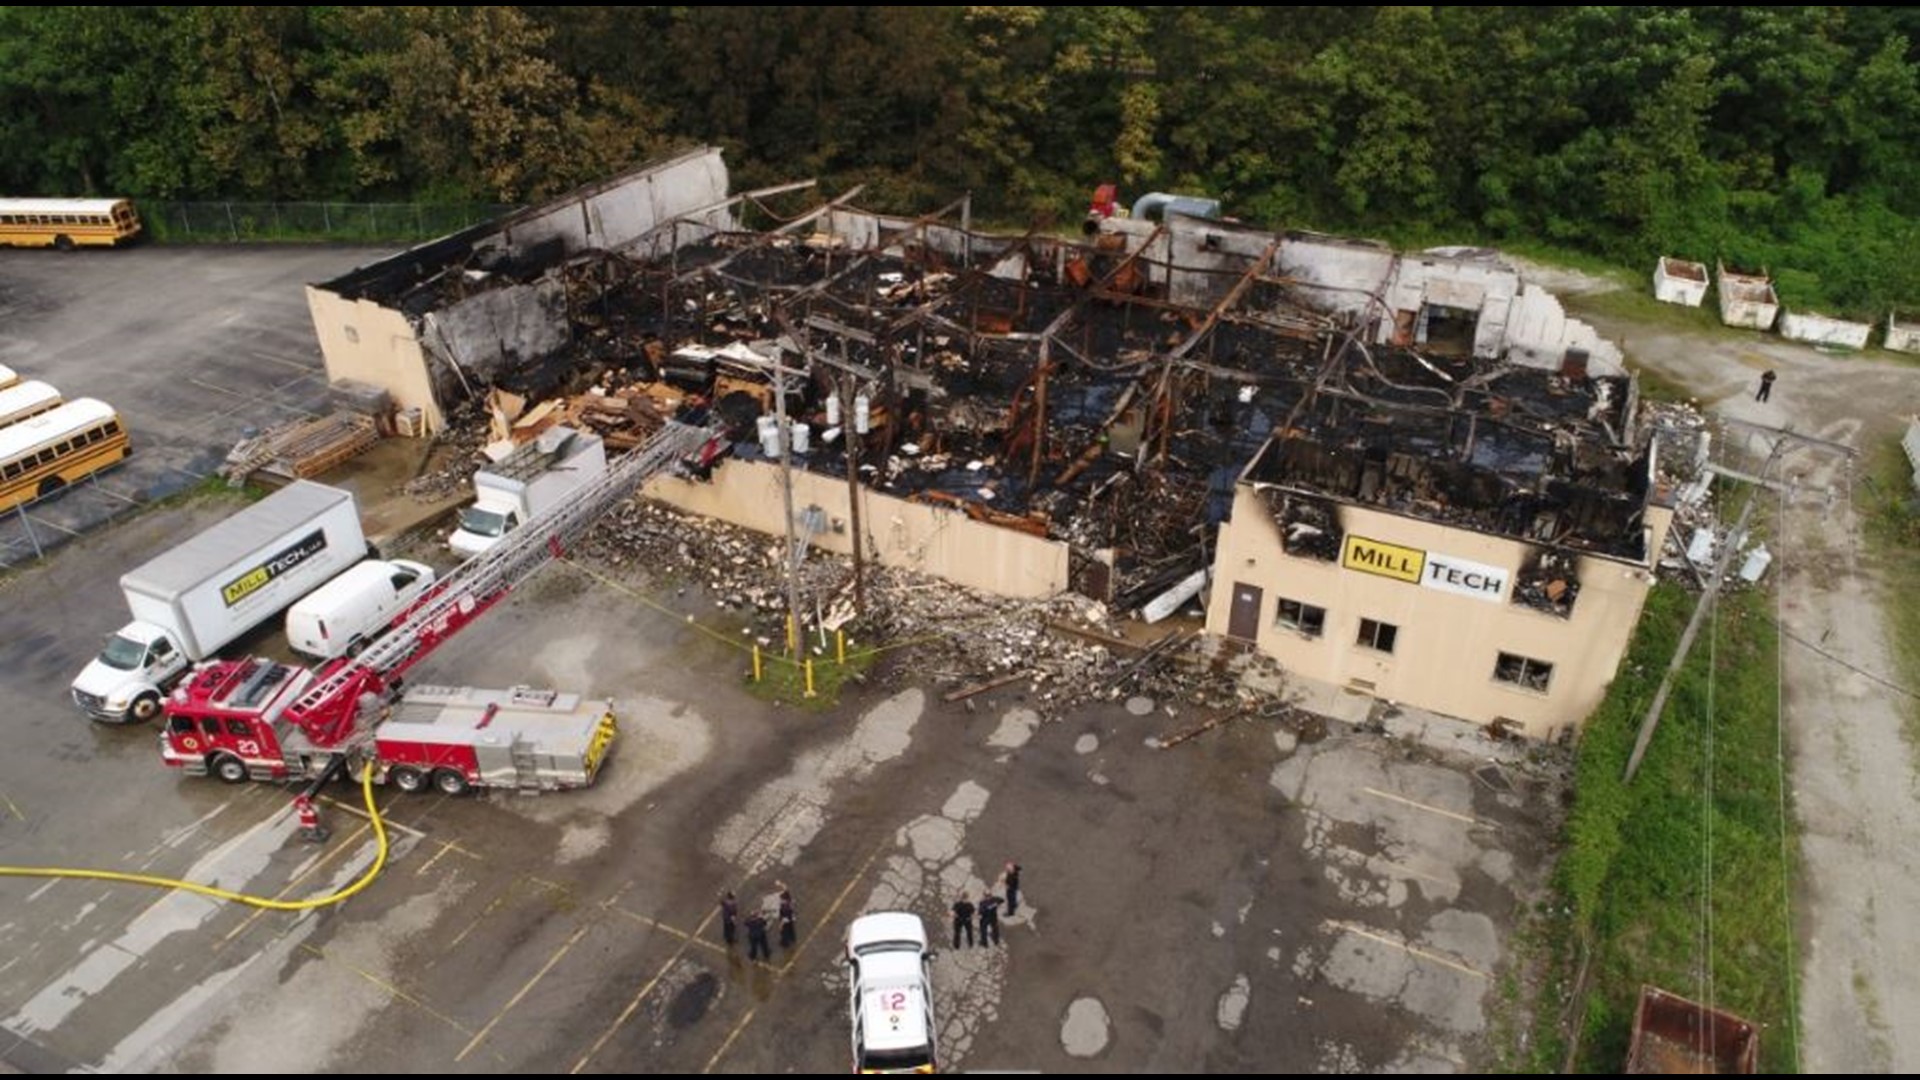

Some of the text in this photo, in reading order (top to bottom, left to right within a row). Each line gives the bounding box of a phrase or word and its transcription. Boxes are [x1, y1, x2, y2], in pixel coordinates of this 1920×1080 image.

[1353, 545, 1502, 593] MILL TECH
[228, 573, 266, 599] MILL
[237, 740, 259, 754] 23
[891, 992, 905, 1010] 2
